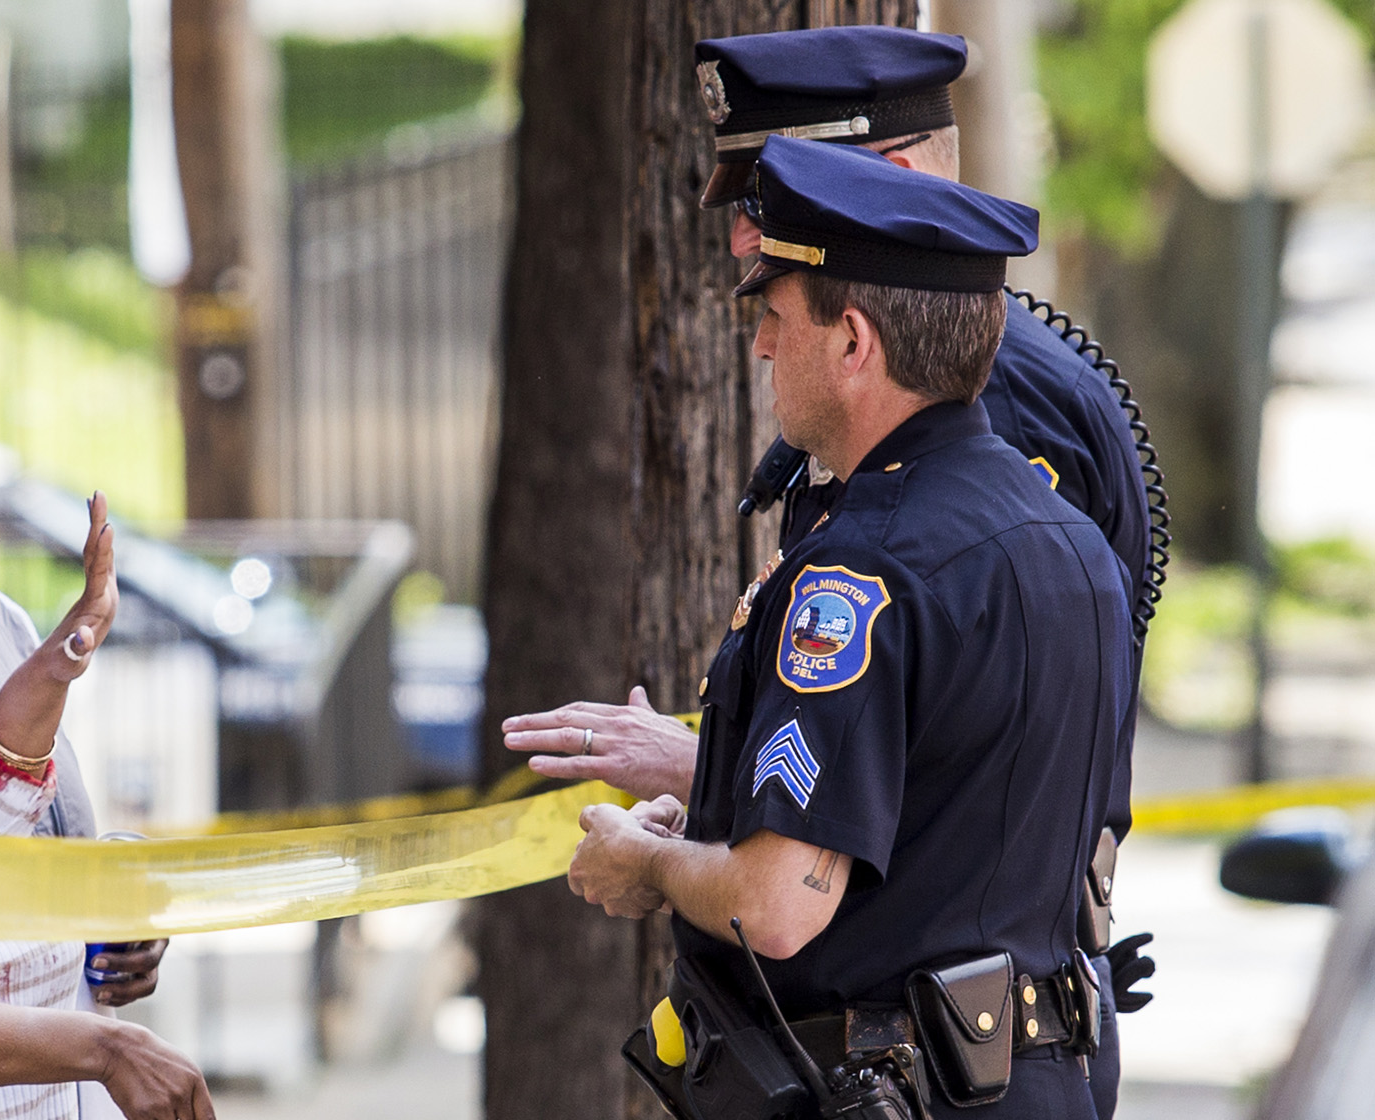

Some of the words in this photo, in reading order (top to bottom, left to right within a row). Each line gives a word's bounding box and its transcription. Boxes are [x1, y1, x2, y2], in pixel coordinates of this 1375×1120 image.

[801, 579, 871, 606] WILMINGTON
[787, 651, 837, 670] POLICE
[791, 666, 819, 680] DEL.
